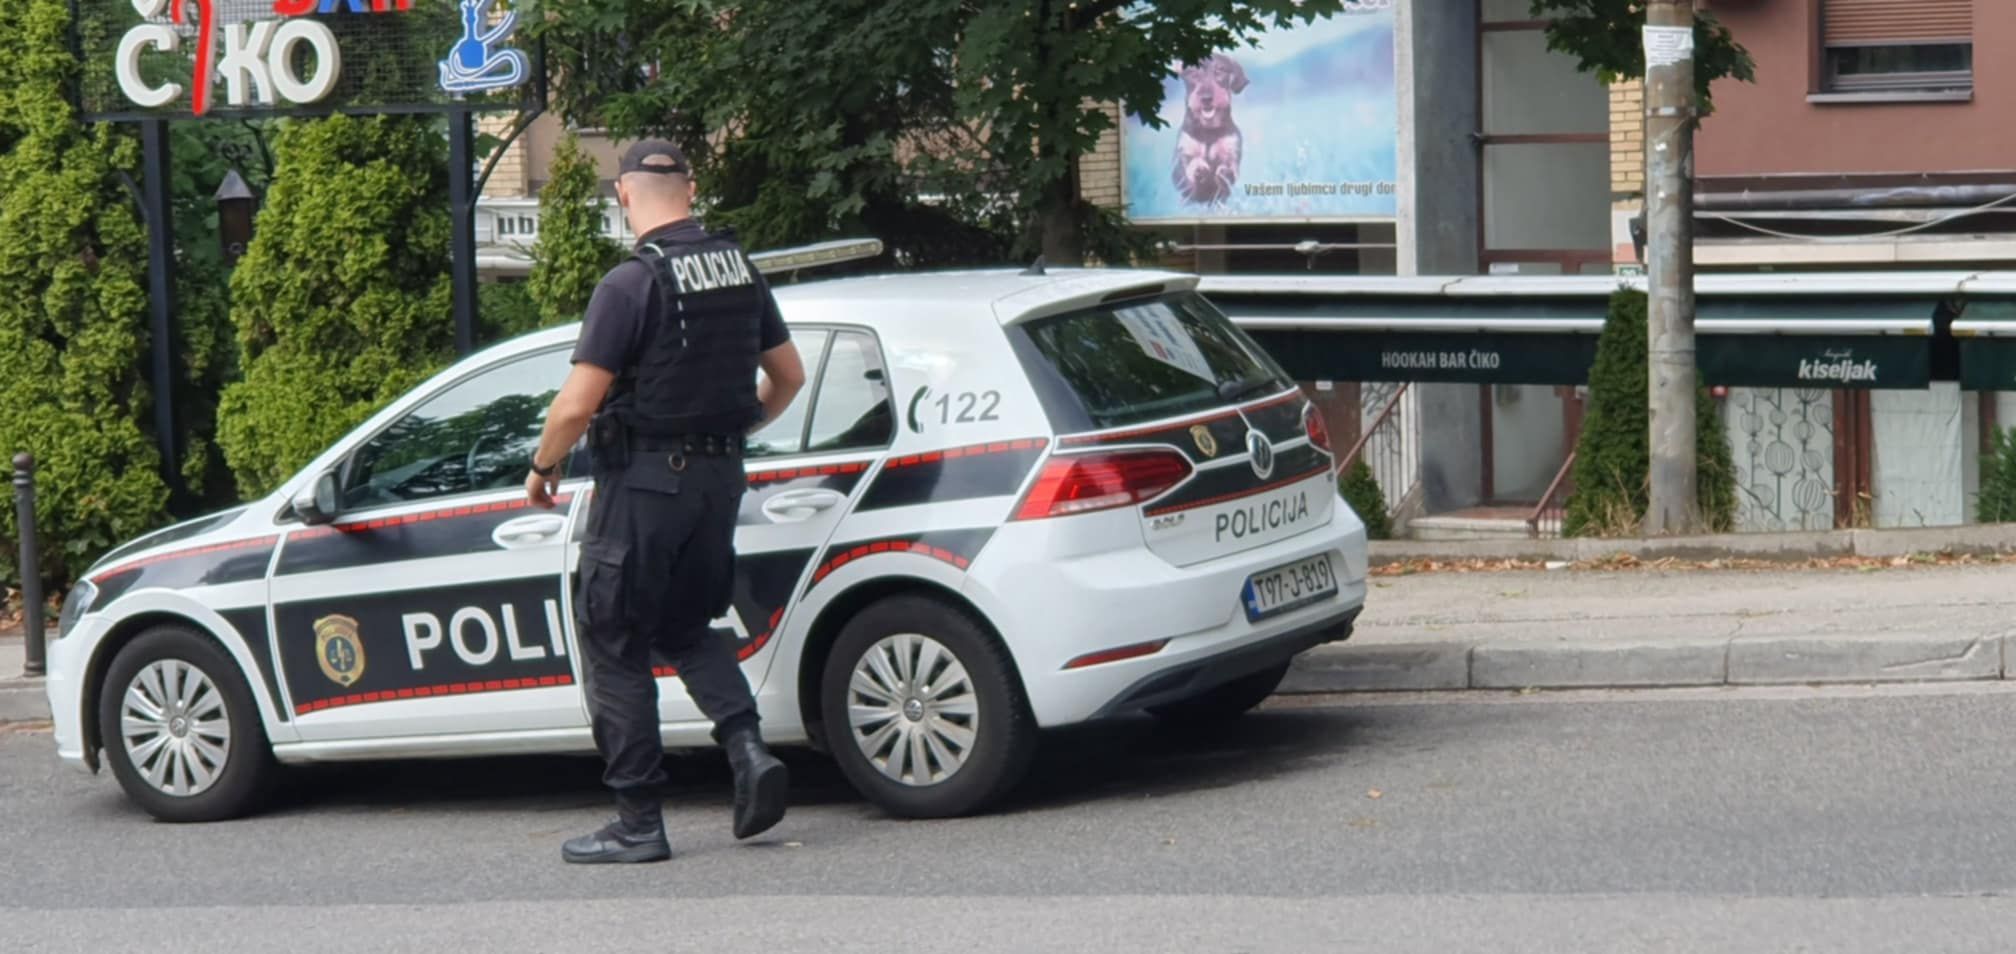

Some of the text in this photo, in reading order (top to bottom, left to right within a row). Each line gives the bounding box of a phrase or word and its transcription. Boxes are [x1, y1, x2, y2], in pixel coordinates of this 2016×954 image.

[1245, 183, 1284, 196] Vašem
[1287, 183, 1336, 197] ljubimcu
[1340, 182, 1373, 196] drugi
[671, 249, 752, 293] POLICIJA
[1382, 349, 1500, 368] HOOKAH BAR ČIKO
[1798, 358, 1877, 382] kiseljak
[935, 390, 1001, 424] 122
[1215, 491, 1308, 542] POLICIJA
[1254, 561, 1329, 607] T97-J-819
